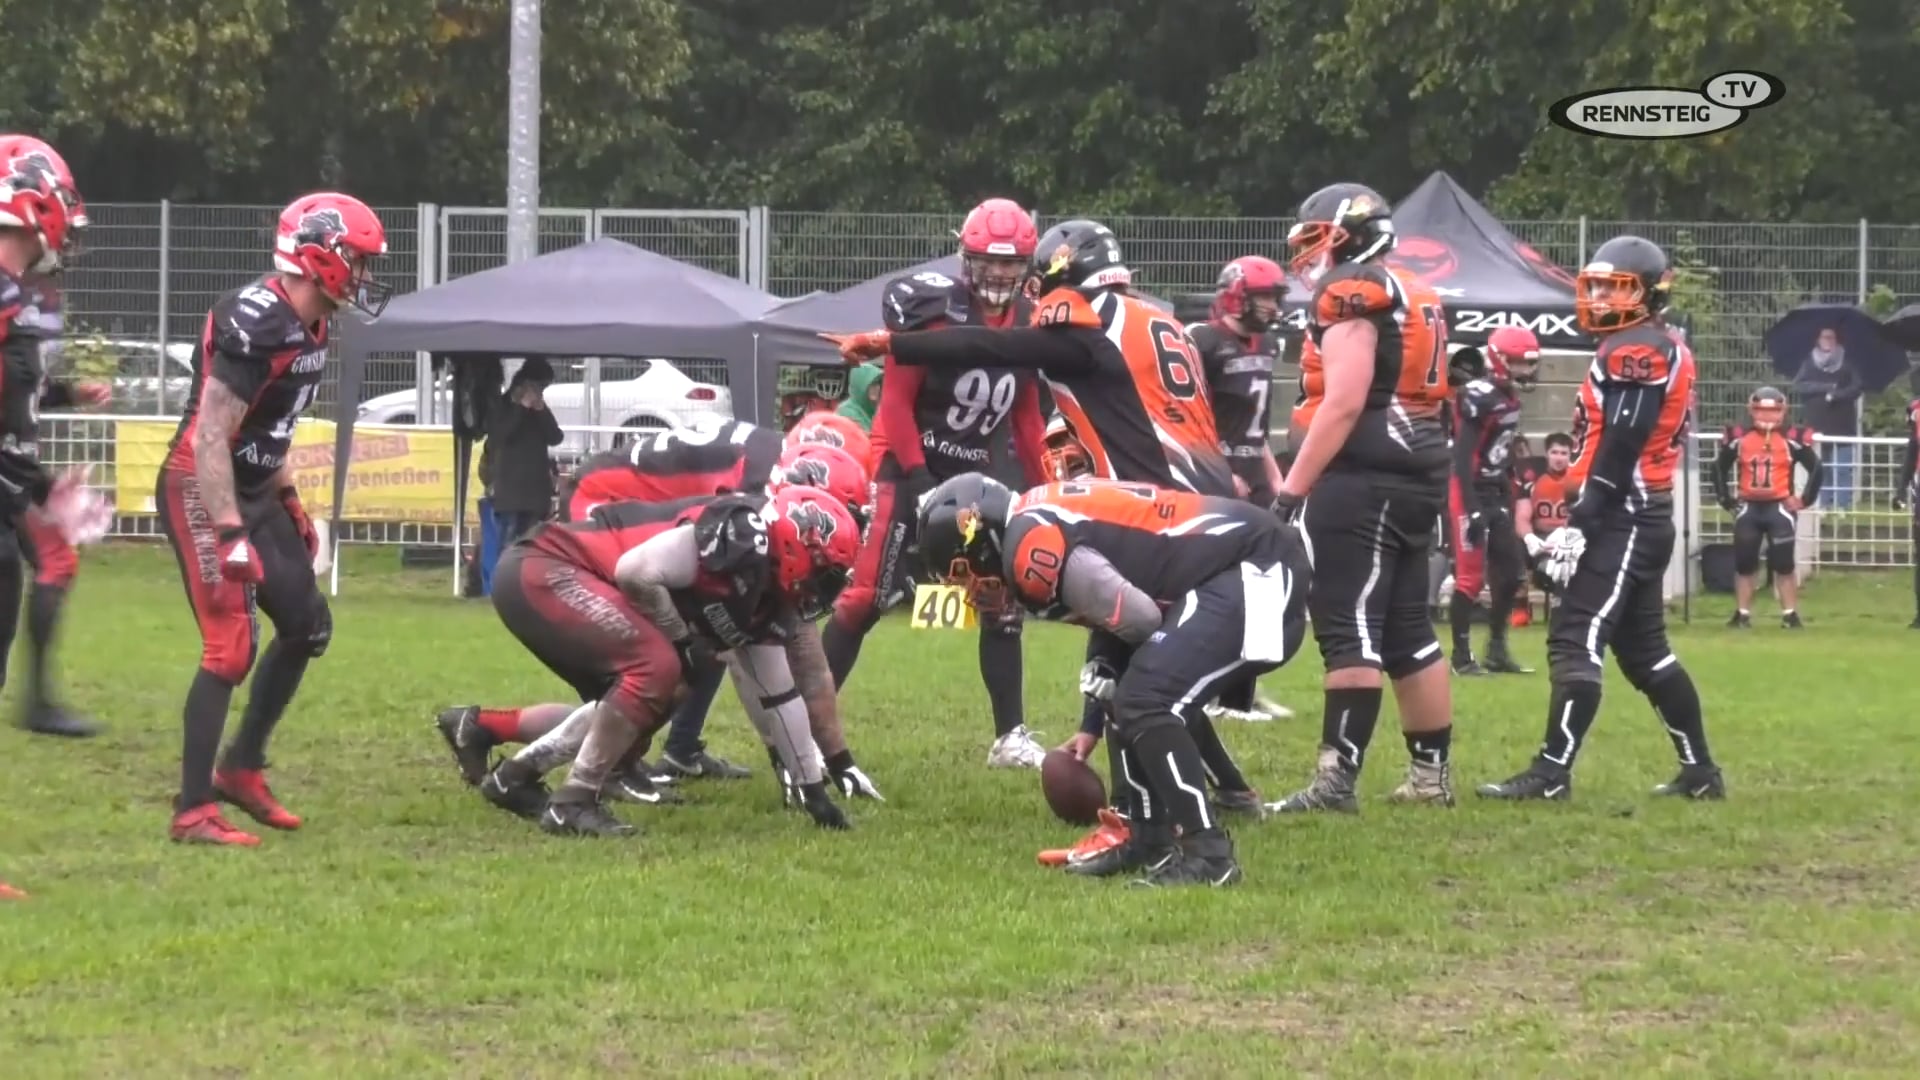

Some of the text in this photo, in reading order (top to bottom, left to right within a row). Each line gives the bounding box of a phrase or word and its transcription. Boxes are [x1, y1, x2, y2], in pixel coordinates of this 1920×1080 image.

[1455, 310, 1579, 336] 24MX
[946, 368, 1017, 436] 99
[347, 467, 439, 491] genießen
[1749, 454, 1773, 491] 11
[1024, 547, 1060, 590] 70
[917, 591, 961, 628] 40
